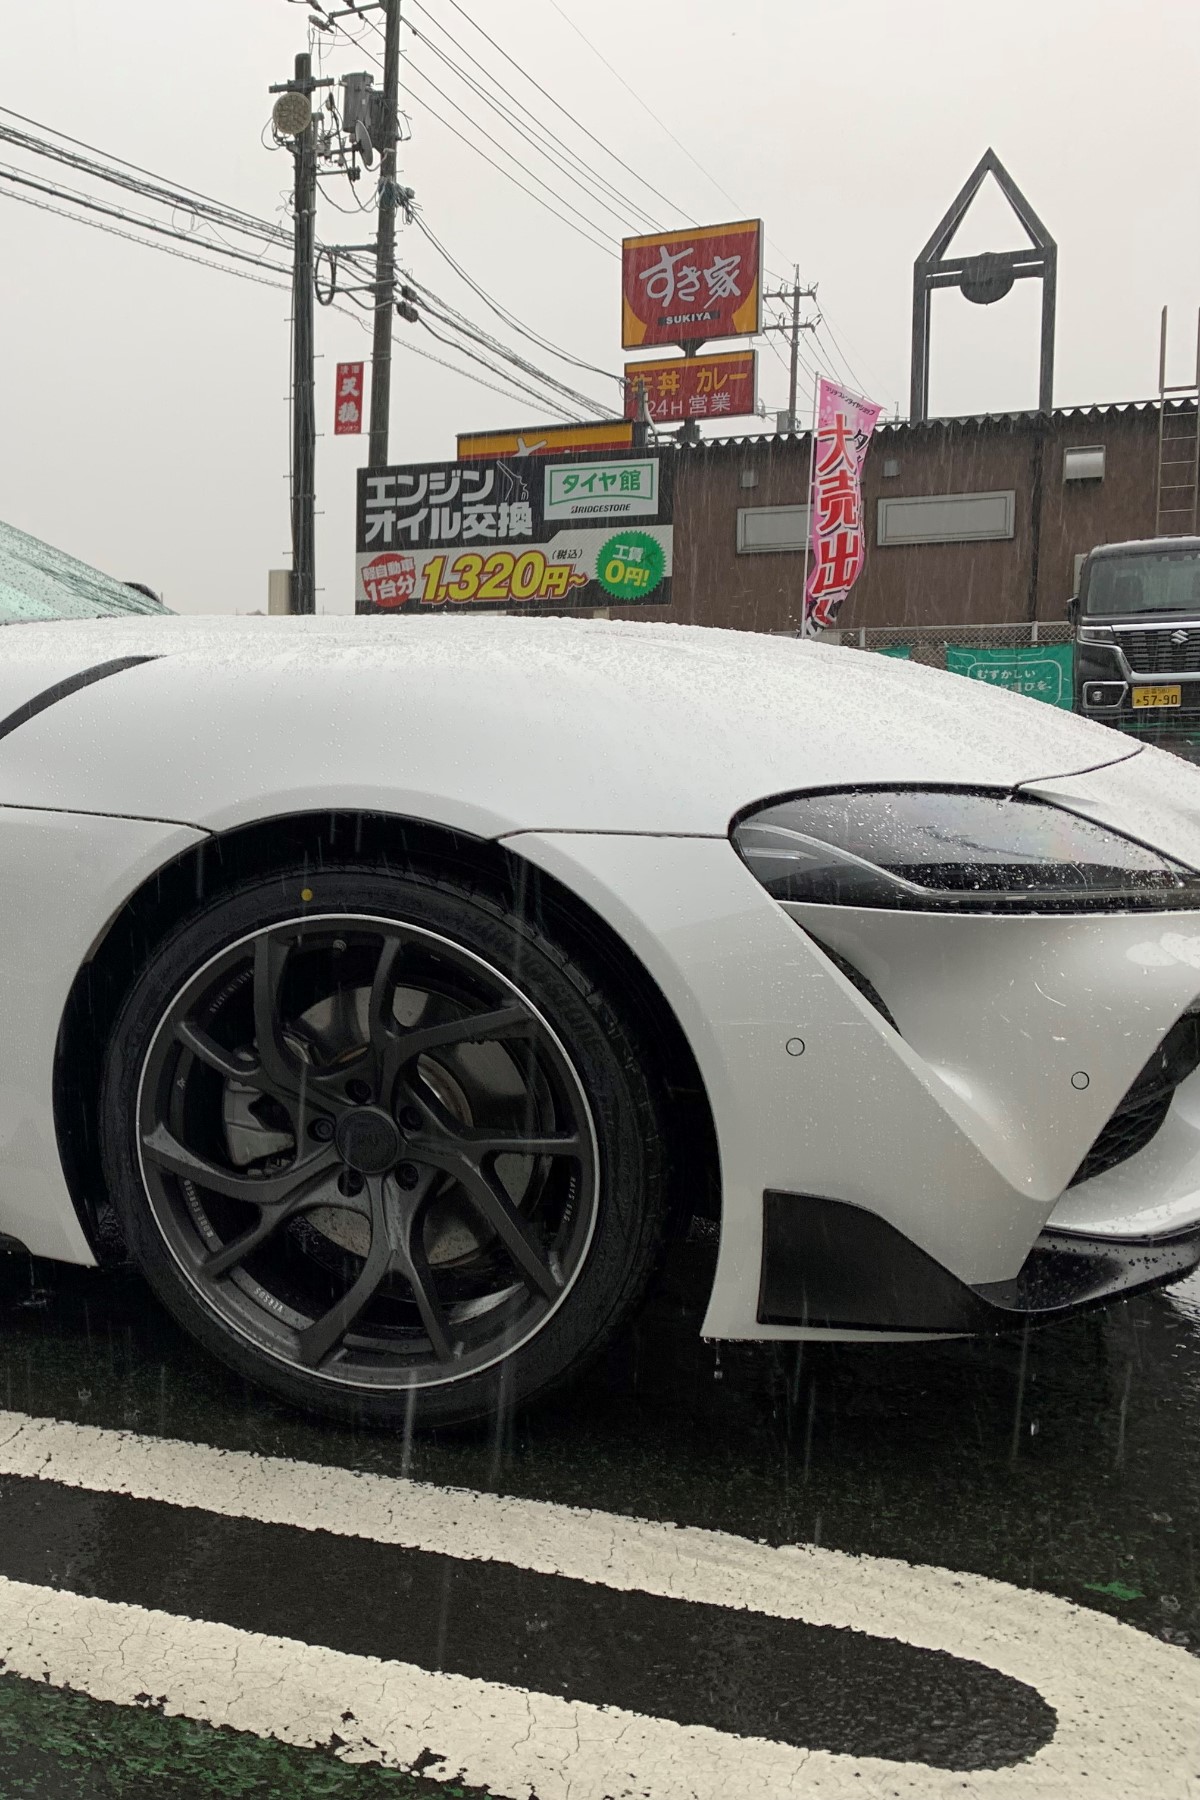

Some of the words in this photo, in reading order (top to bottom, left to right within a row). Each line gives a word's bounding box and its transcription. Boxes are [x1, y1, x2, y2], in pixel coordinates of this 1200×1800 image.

[639, 245, 742, 309] すき家
[666, 312, 712, 325] SUKIYA
[697, 367, 747, 392] カレー
[648, 399, 682, 417] 24H
[689, 392, 731, 414] 営業
[366, 469, 494, 508] エンジン
[562, 470, 642, 495] タイヤ館
[571, 503, 632, 514] BRIDGESTONE
[365, 501, 534, 543] オイル交換
[367, 574, 415, 602] 1台分
[977, 669, 1036, 680] むずかしい
